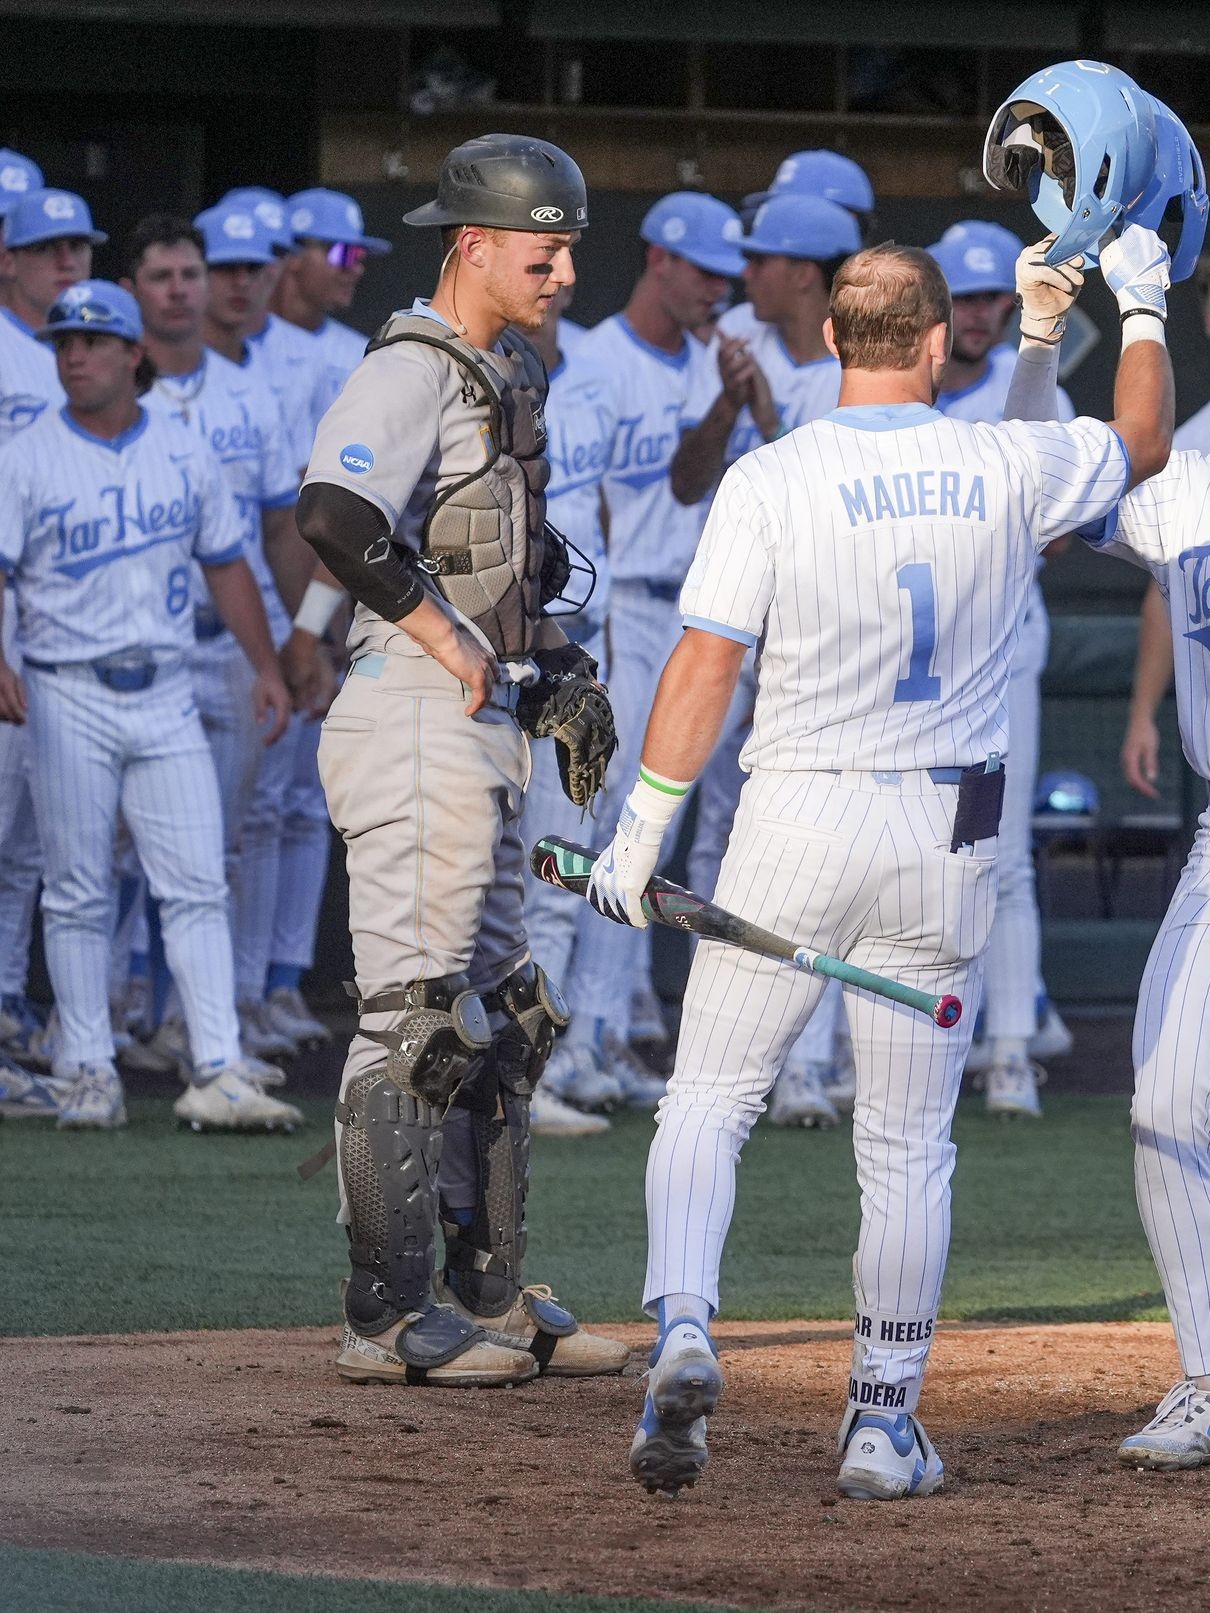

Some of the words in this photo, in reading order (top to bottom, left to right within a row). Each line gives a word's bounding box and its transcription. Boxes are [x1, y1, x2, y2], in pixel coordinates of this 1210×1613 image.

[342, 454, 371, 470] NCAA
[838, 470, 986, 527] MADERA
[38, 498, 111, 560] Tar
[166, 565, 191, 617] 8
[893, 562, 942, 703] 1
[855, 1312, 873, 1338] AR
[880, 1318, 933, 1342] HEELS
[849, 1376, 907, 1408] ADERA
